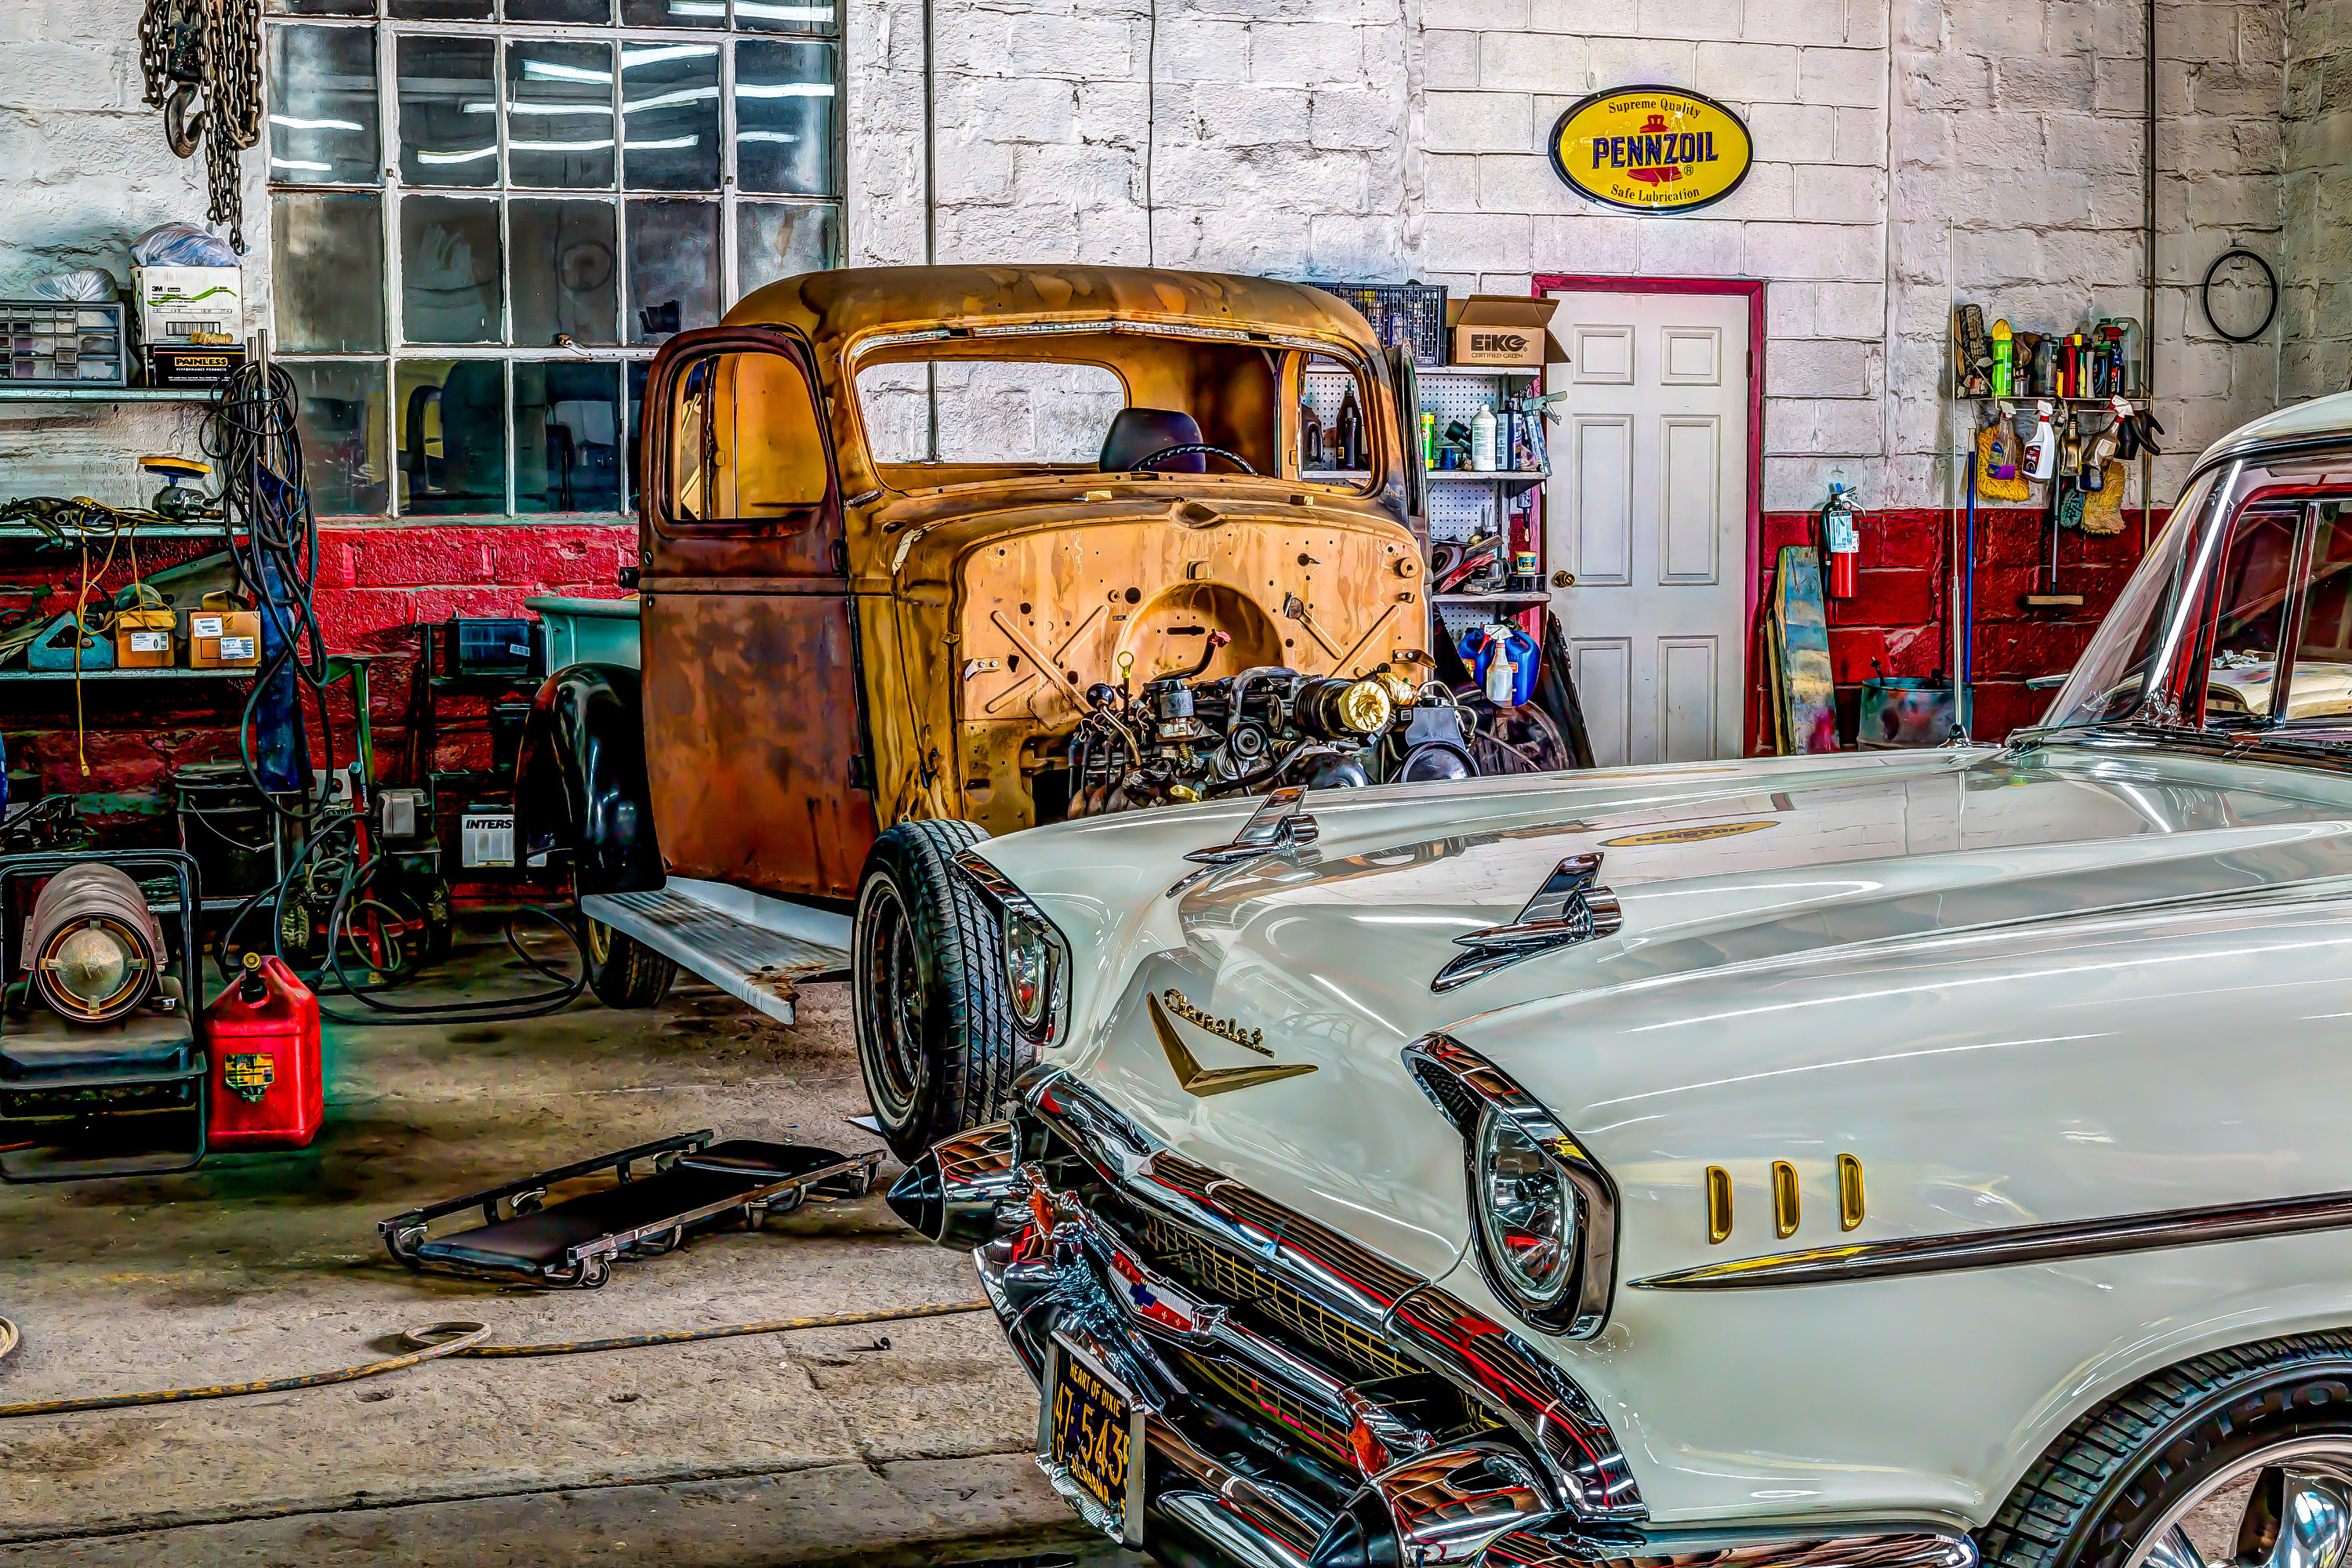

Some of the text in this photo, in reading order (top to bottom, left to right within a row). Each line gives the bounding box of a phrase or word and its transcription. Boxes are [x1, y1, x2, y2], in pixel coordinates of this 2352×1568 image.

[1608, 99, 1701, 118] Supreme Quality
[1592, 132, 1719, 169] PENNZOIL
[1610, 183, 1700, 203] Safe Lubrication
[174, 357, 228, 367] PAINLESS
[1163, 989, 1273, 1058] Chevrolet
[1069, 1363, 1121, 1418] HEART OF DIXIE
[1071, 1456, 1110, 1507] ALABAMA
